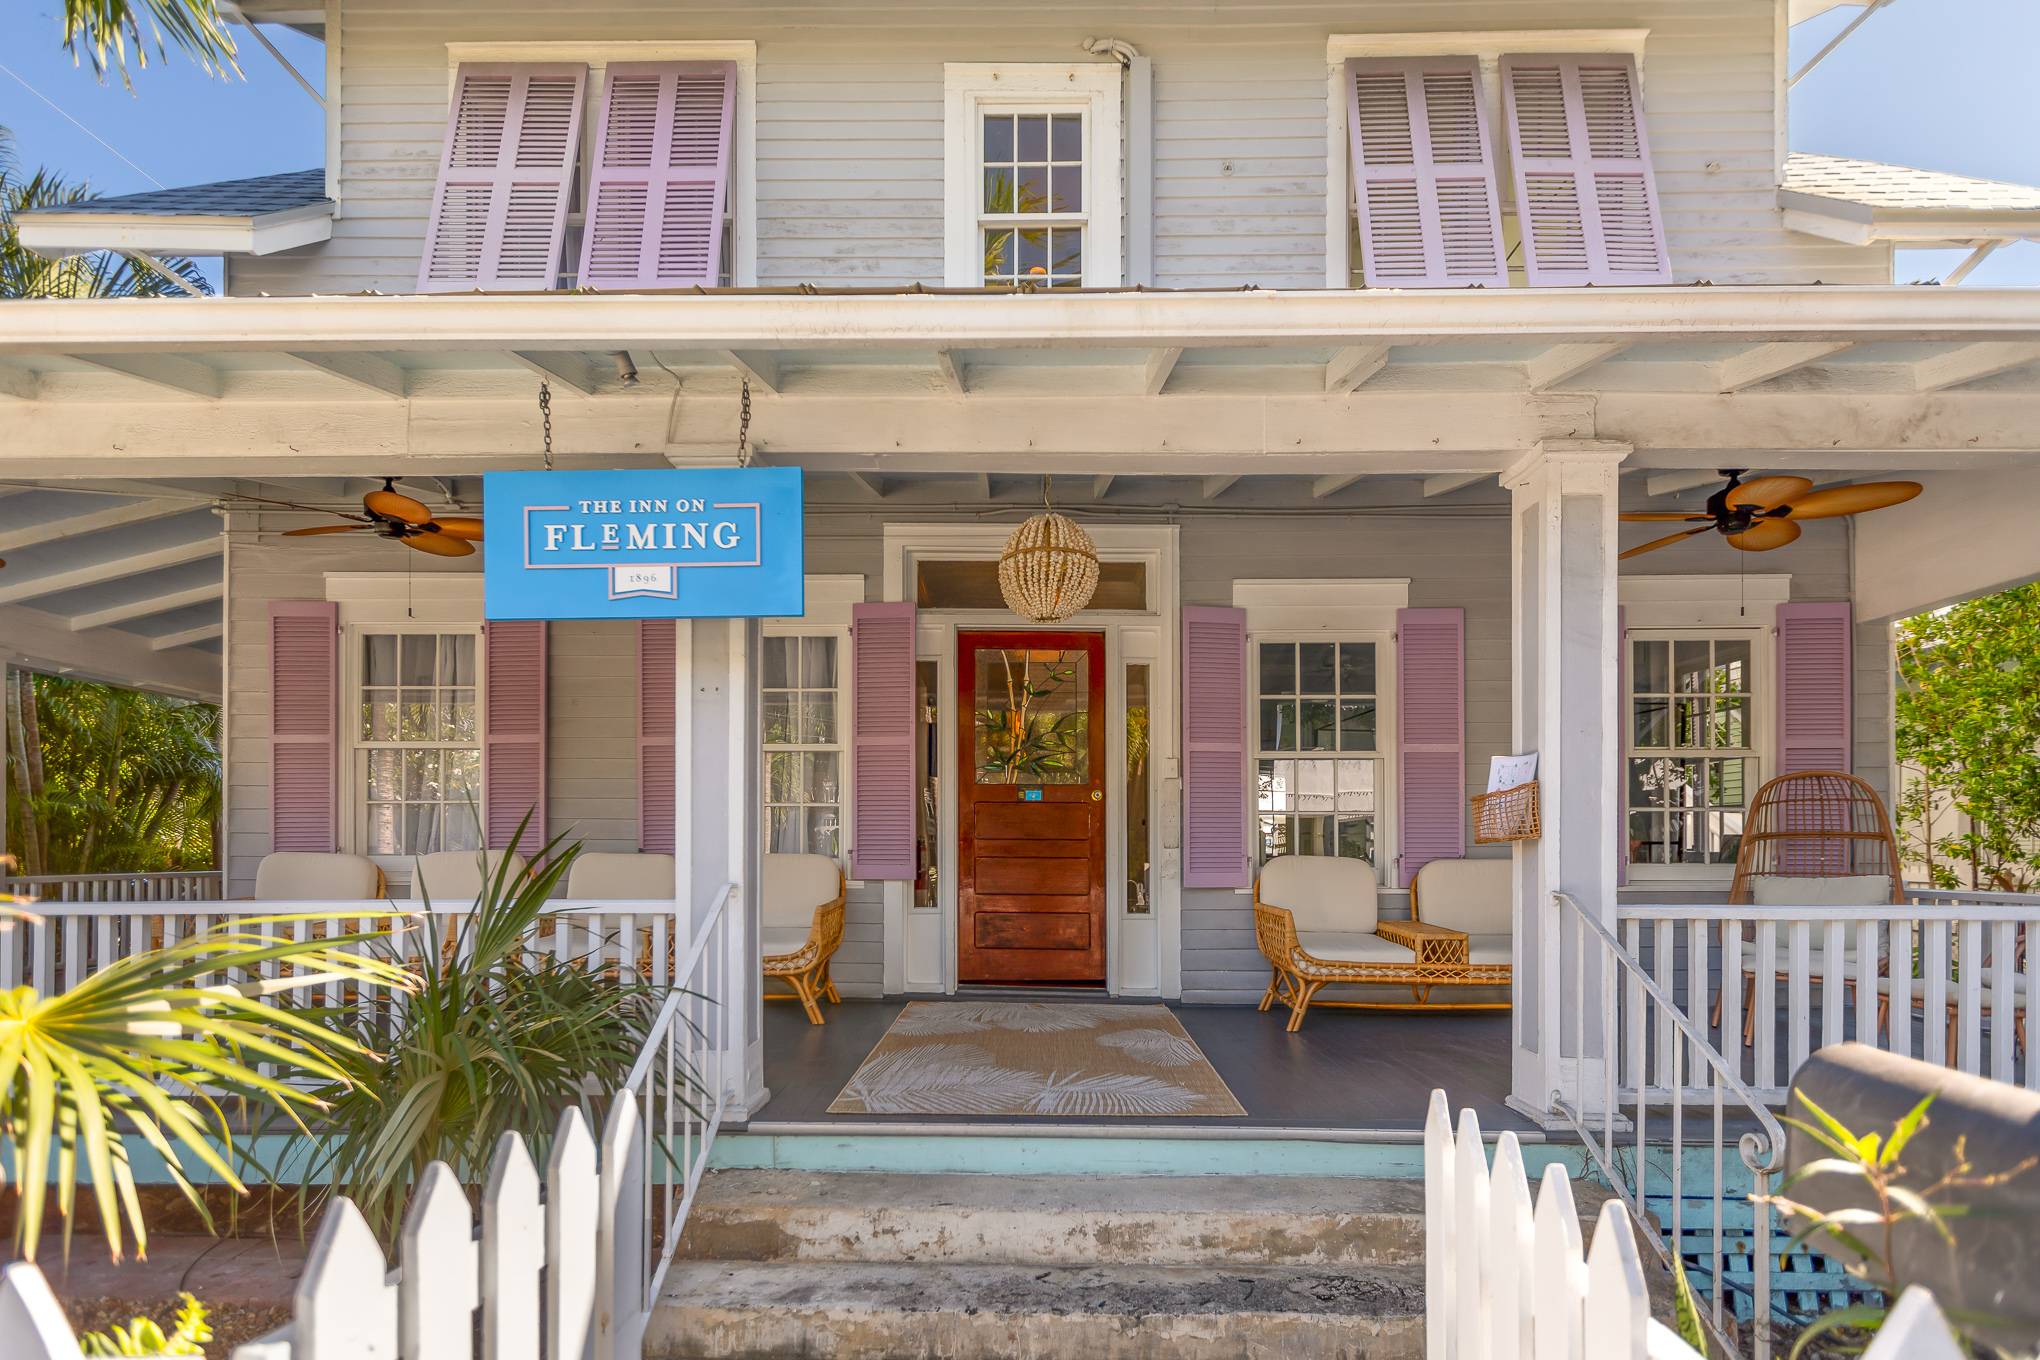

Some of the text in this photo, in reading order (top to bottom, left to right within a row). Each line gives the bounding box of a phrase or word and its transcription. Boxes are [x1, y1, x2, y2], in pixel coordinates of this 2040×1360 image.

[578, 498, 705, 513] THE INN ON
[543, 521, 741, 551] FLEMING
[629, 573, 657, 585] 1896
